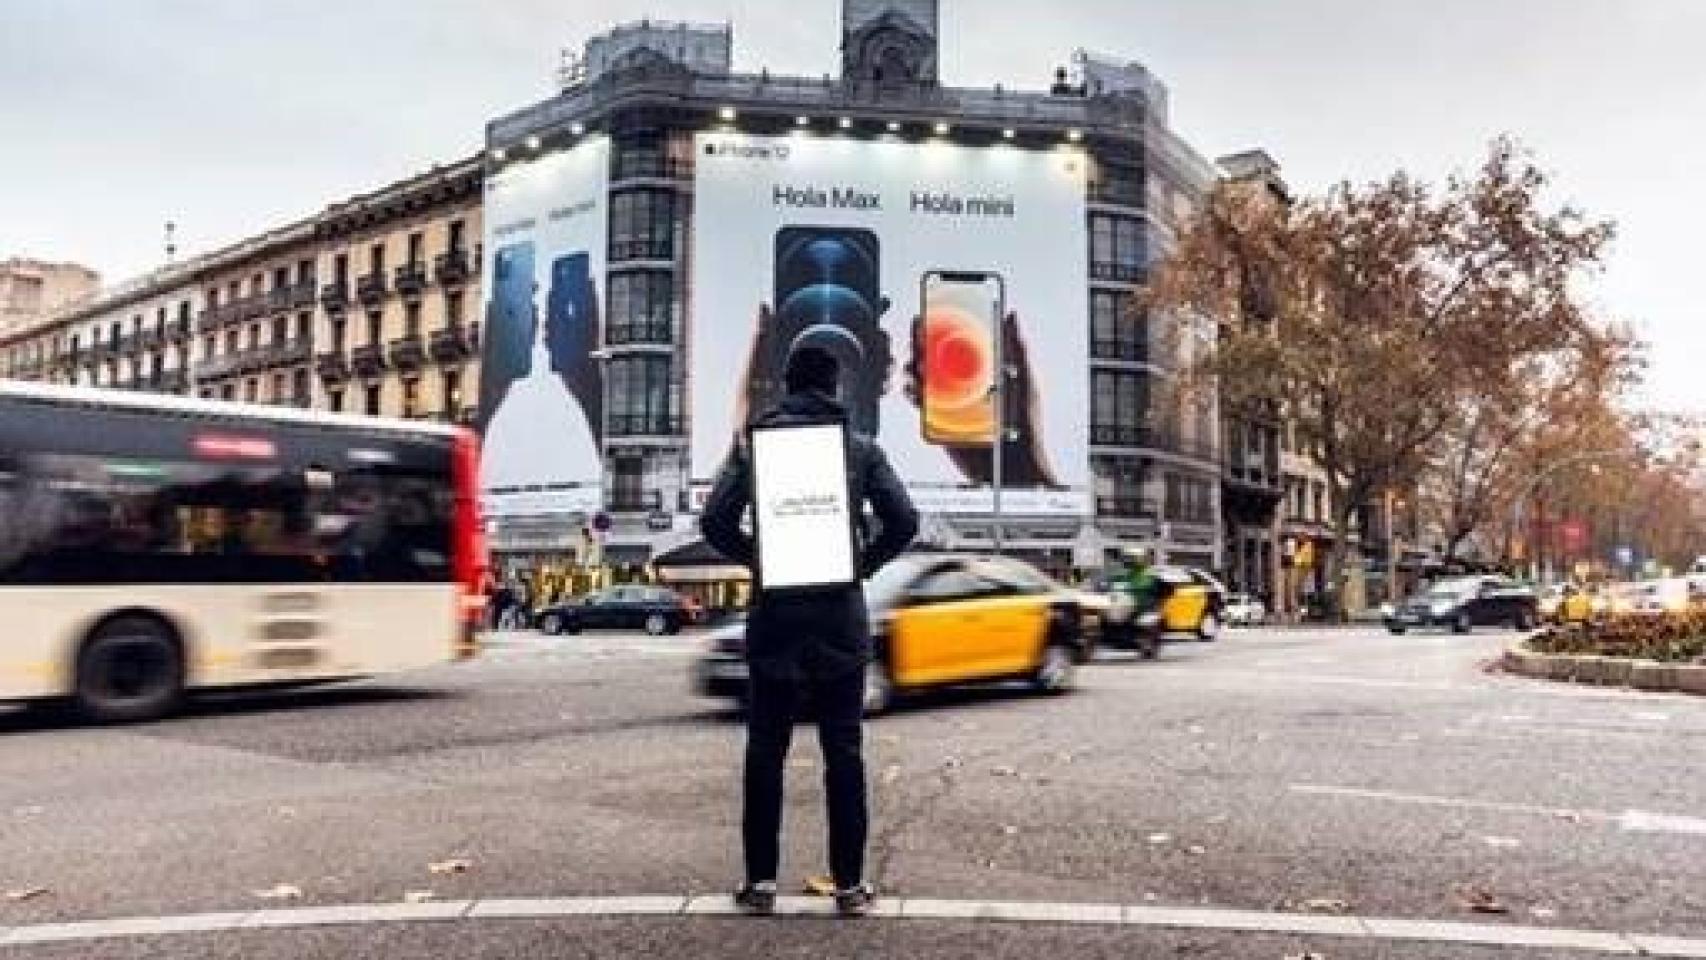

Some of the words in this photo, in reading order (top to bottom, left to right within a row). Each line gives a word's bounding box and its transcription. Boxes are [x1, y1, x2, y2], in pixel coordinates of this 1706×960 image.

[772, 184, 827, 209] Hola
[832, 187, 882, 210] Max
[909, 190, 964, 215] Hola
[966, 193, 1014, 217] mini
